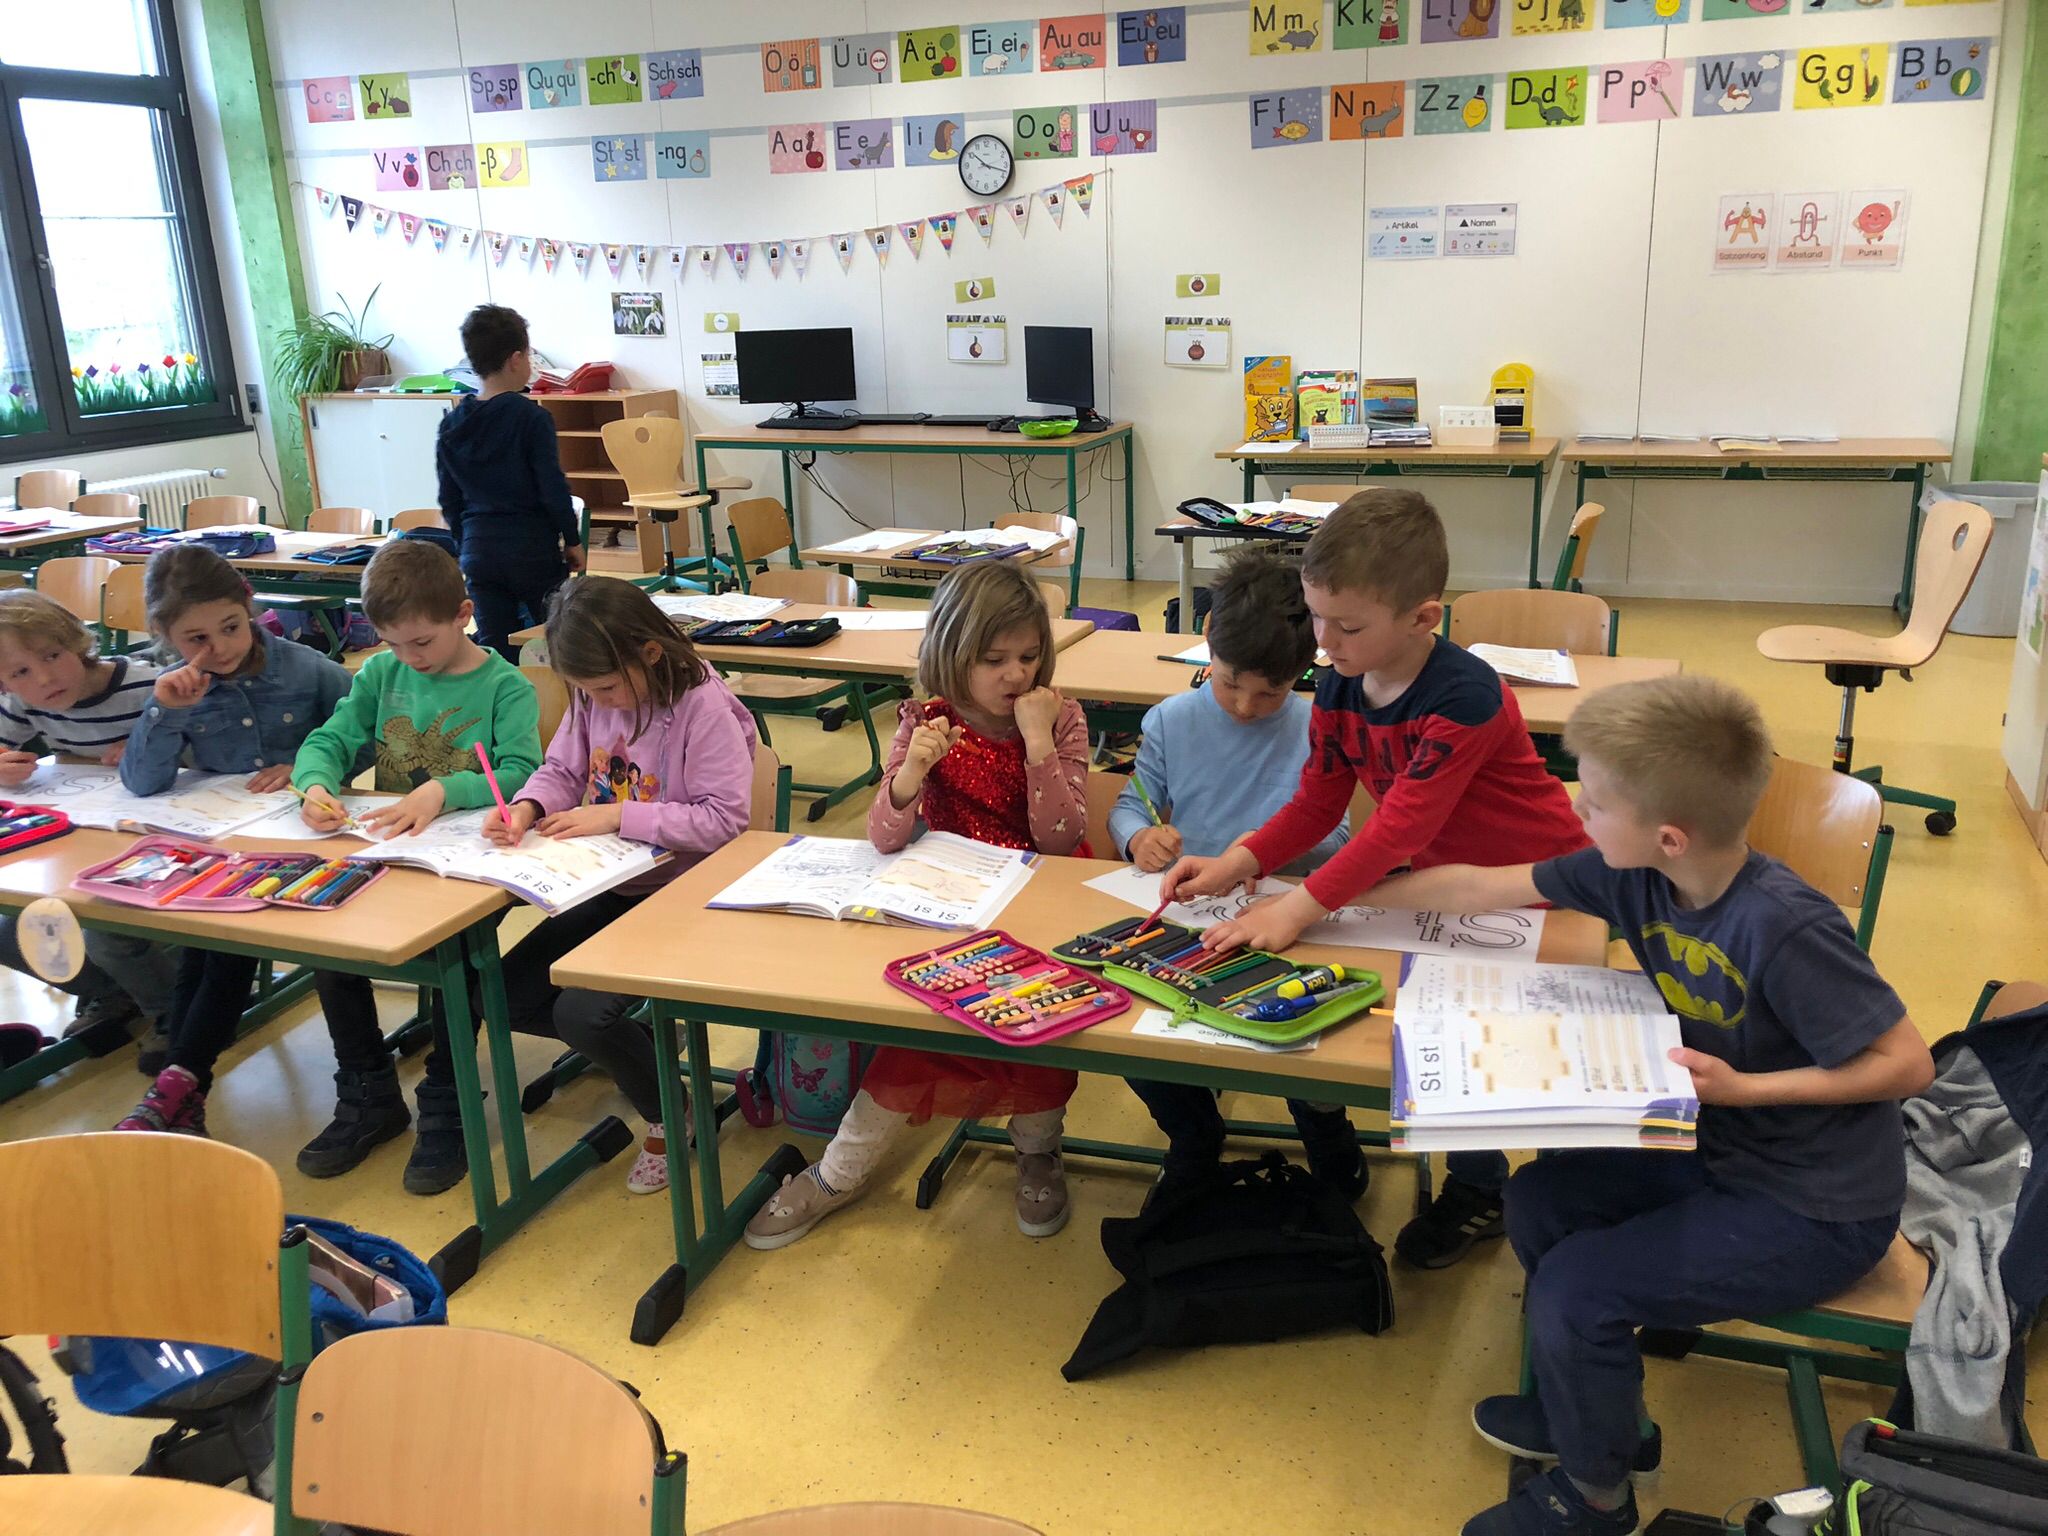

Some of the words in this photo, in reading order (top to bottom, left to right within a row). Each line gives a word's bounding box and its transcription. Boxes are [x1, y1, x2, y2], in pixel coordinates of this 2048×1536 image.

[1121, 17, 1148, 43] Eu
[1156, 24, 1179, 40] eu
[1254, 5, 1275, 32] M
[1285, 14, 1302, 30] m
[903, 33, 919, 63] Ä
[925, 42, 936, 60] ä
[972, 30, 991, 55] Ei
[1002, 33, 1017, 52] ei
[1043, 24, 1071, 50] Au
[1078, 32, 1101, 47] au
[766, 44, 782, 73] Ö
[789, 54, 799, 71] ö
[834, 38, 849, 67] Ü
[857, 48, 867, 66] ü
[1901, 48, 1924, 77] B
[1935, 47, 1951, 75] b
[528, 67, 553, 90] Qu
[557, 74, 575, 96] qu
[590, 62, 616, 85] -ch
[1703, 61, 1736, 93] W
[1741, 71, 1763, 89] w
[1802, 55, 1826, 83] G
[1837, 65, 1854, 94] g
[362, 80, 374, 101] Y
[380, 88, 388, 109] y
[471, 72, 494, 102] Sp
[500, 78, 517, 100] sp
[1420, 84, 1439, 112] Z
[1447, 95, 1459, 110] z
[1511, 78, 1532, 105] D
[1542, 75, 1556, 103] d
[1604, 70, 1623, 98] P
[1631, 80, 1646, 108] p
[1254, 99, 1269, 126] F
[1278, 97, 1285, 123] f
[1335, 91, 1353, 117] N
[1363, 101, 1375, 115] n
[1017, 115, 1035, 138] O
[1043, 124, 1054, 137] o
[1094, 109, 1110, 134] U
[1119, 118, 1129, 132] u
[595, 141, 614, 162] St
[625, 140, 640, 161] st
[773, 131, 787, 154] A
[793, 140, 803, 152] a
[837, 126, 851, 150] E
[858, 136, 868, 148] e
[374, 153, 386, 173] V
[392, 161, 400, 173] v
[428, 151, 450, 172] Ch
[455, 150, 472, 170] ch
[658, 147, 686, 168] -ng
[1392, 221, 1418, 229] Artikel
[1470, 219, 1496, 227] Nomen
[1787, 250, 1823, 259] Abstand
[1858, 249, 1883, 257] Punkt
[1420, 1071, 1441, 1091] St
